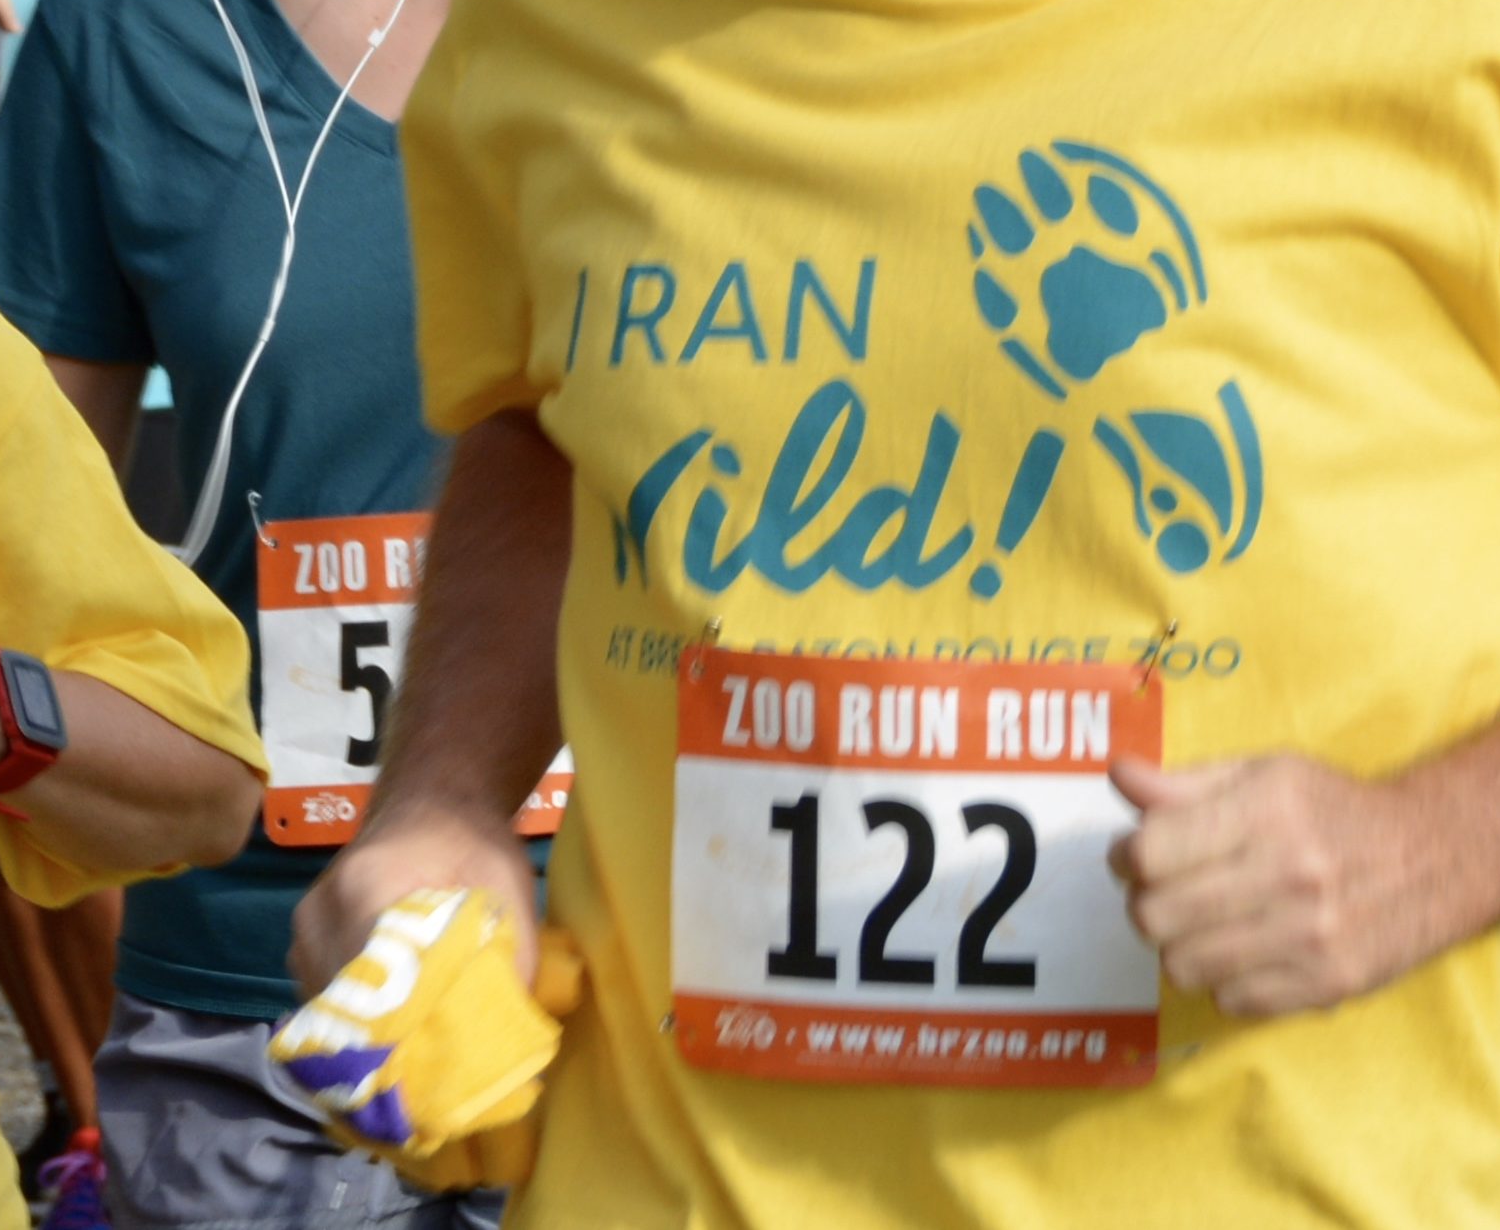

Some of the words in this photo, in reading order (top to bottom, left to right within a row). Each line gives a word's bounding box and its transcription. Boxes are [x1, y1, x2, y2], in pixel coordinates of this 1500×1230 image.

[565, 266, 589, 374] I
[608, 256, 877, 366] RAN
[294, 540, 368, 594] ZOO
[1127, 636, 1243, 679] ZOO
[720, 674, 817, 753] ZOO
[838, 682, 960, 758] RUN
[986, 687, 1112, 763] RUN
[765, 790, 1038, 990] 122
[805, 1021, 1109, 1065] www.brzoo.org
